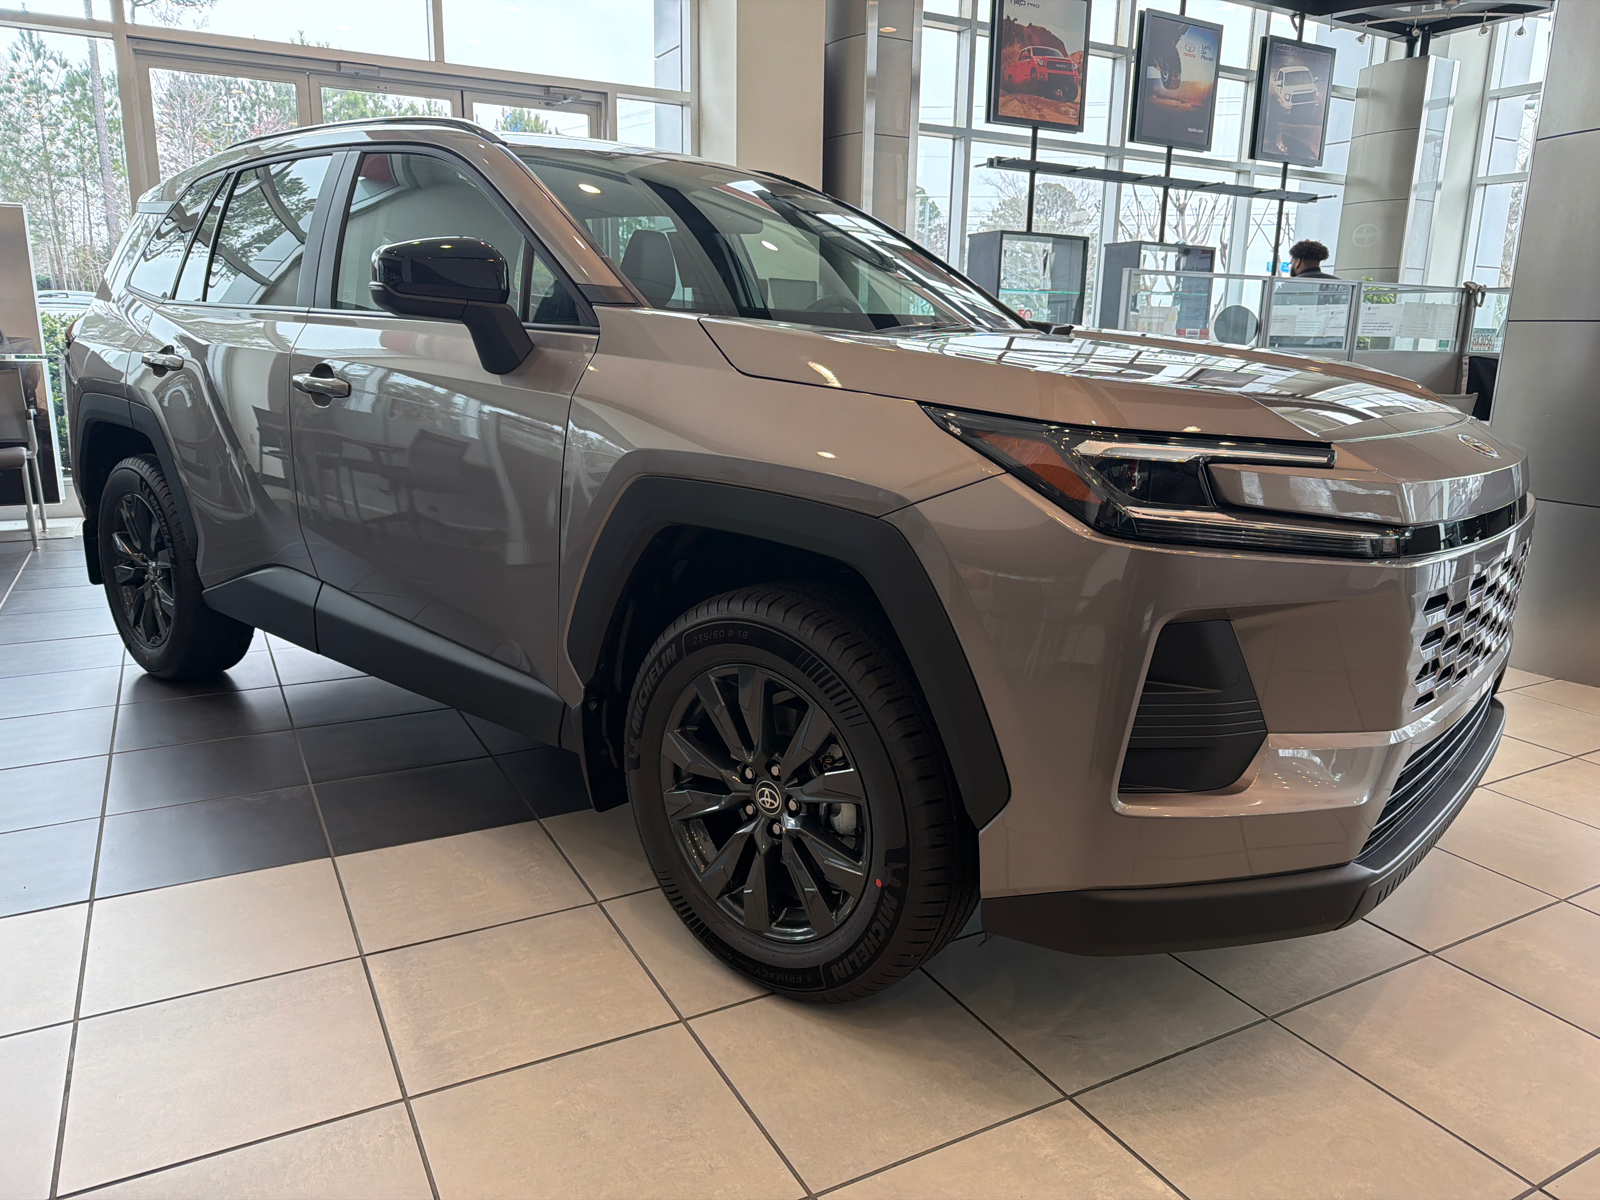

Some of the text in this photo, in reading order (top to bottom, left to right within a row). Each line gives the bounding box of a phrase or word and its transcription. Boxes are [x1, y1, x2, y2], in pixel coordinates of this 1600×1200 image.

[147, 493, 176, 559] MICHELIN
[693, 630, 749, 645] 235/60 R 18
[631, 643, 678, 735] MICHELIN
[830, 889, 899, 981] MICHELIN
[755, 967, 802, 983] PRIMACY
